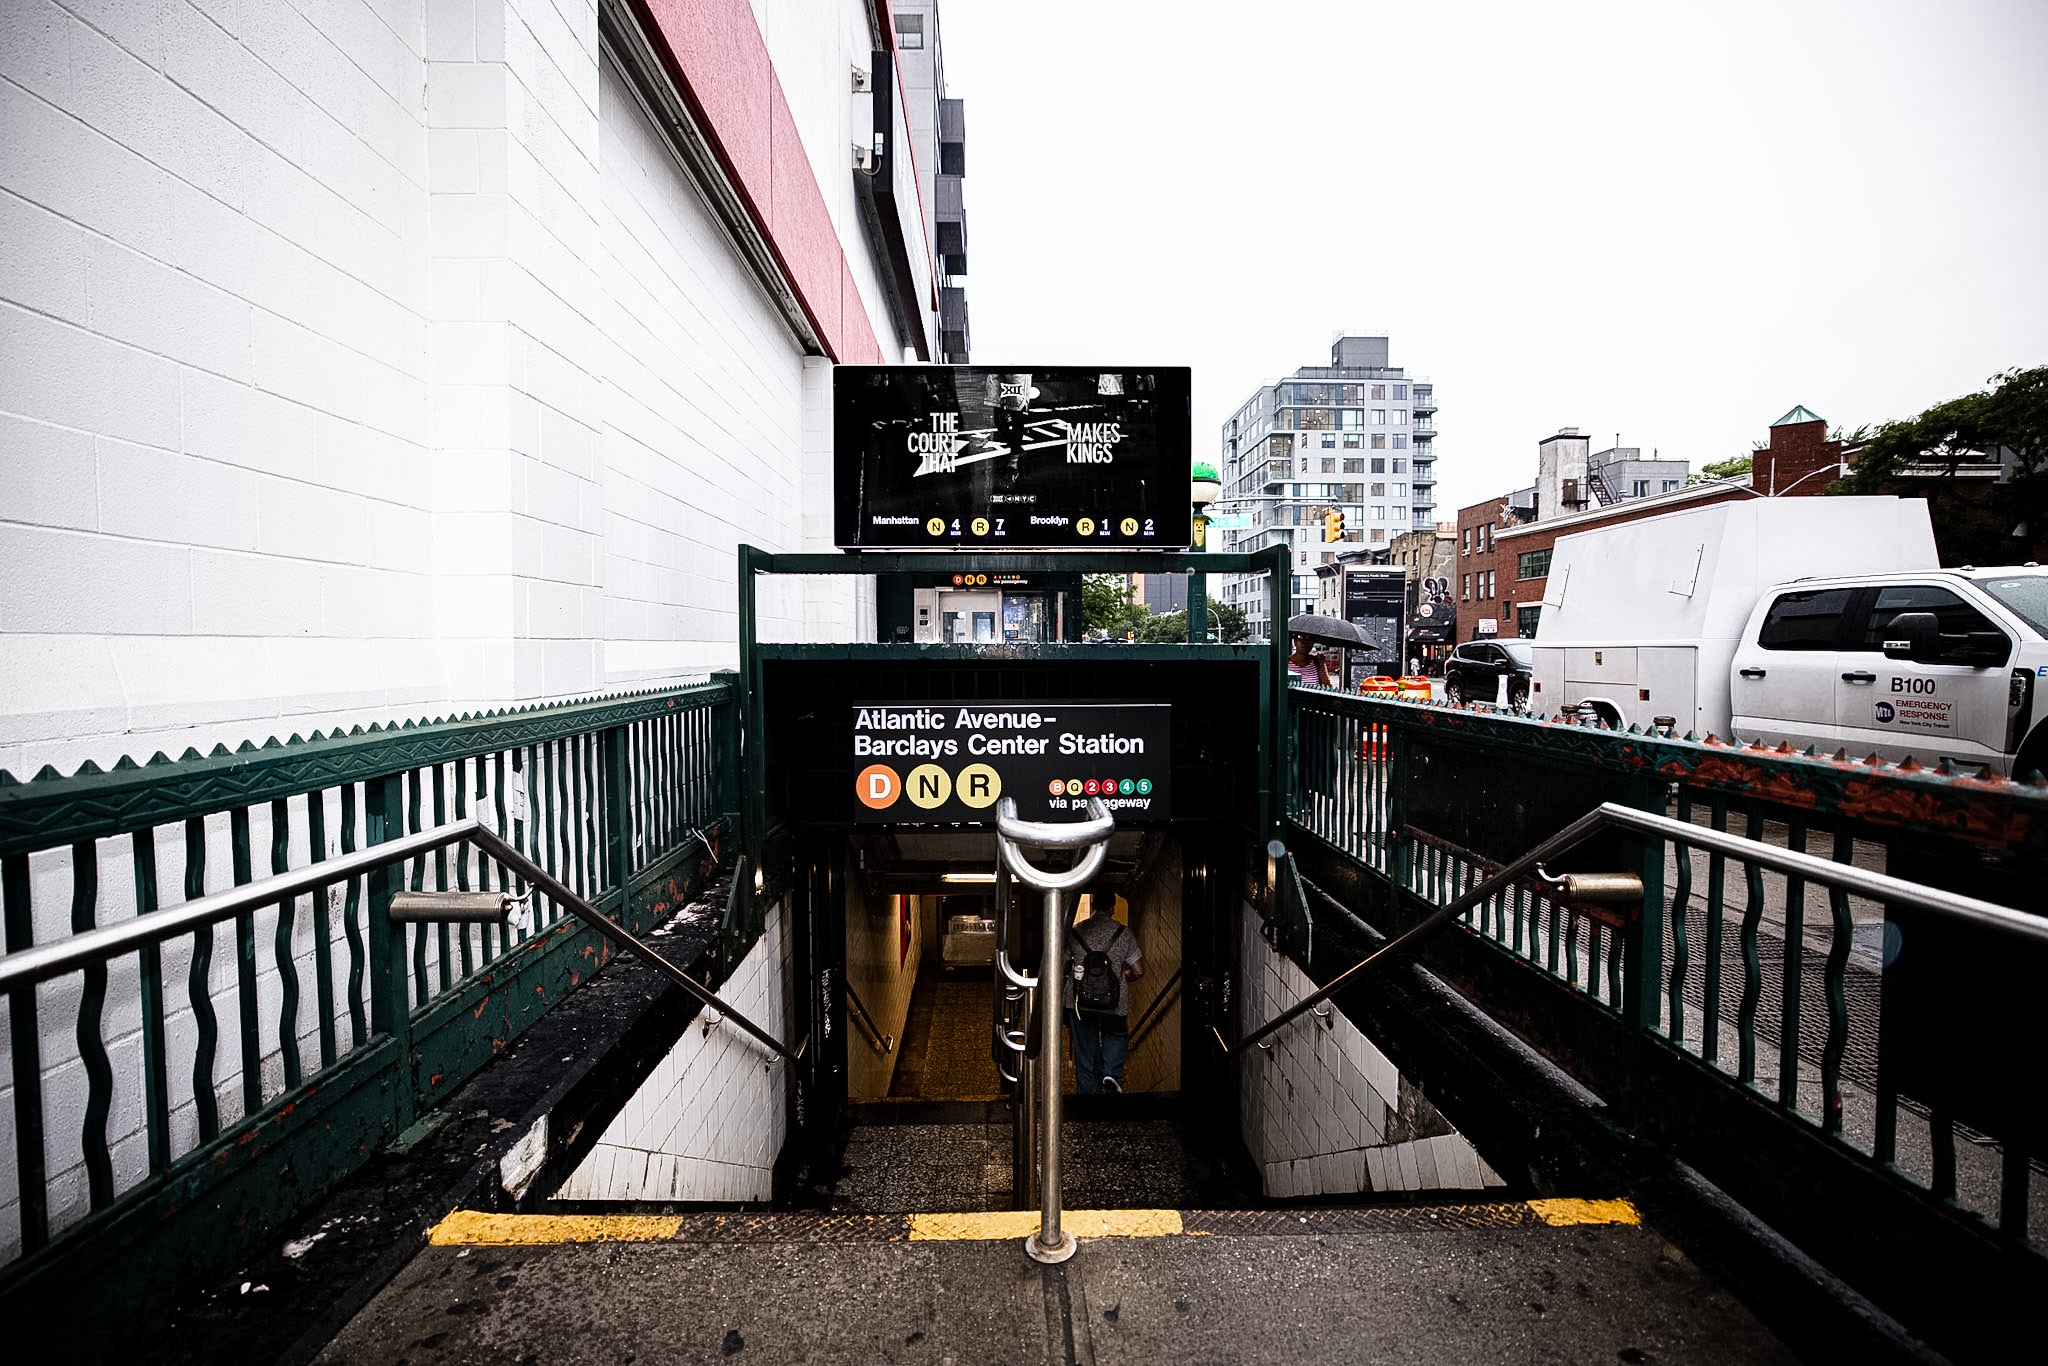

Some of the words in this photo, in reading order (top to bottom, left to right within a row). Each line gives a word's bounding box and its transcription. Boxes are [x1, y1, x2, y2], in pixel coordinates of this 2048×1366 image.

[930, 412, 959, 433] THE
[907, 432, 959, 453] COURT
[1066, 423, 1121, 443] MAKES
[919, 452, 959, 473] THAT
[1066, 443, 1113, 464] KINGS
[872, 516, 920, 525] Manhattan
[951, 519, 960, 530] 4
[995, 519, 1005, 530] 7
[1030, 516, 1069, 526] Brooklyn
[1101, 519, 1109, 530] 1
[1145, 519, 1154, 530] 2
[1891, 677, 1936, 694] B100
[1895, 700, 1953, 711] EMERGENCY
[1899, 709, 1948, 721] RESPONSE
[855, 709, 945, 730] Atlantic
[854, 735, 958, 760] Barclays
[967, 733, 1049, 755] Center
[1058, 733, 1144, 755] Station
[869, 773, 892, 799] D
[919, 774, 939, 799] N
[970, 773, 990, 797] R
[1049, 796, 1068, 808] via
[1072, 797, 1151, 810] paageway
